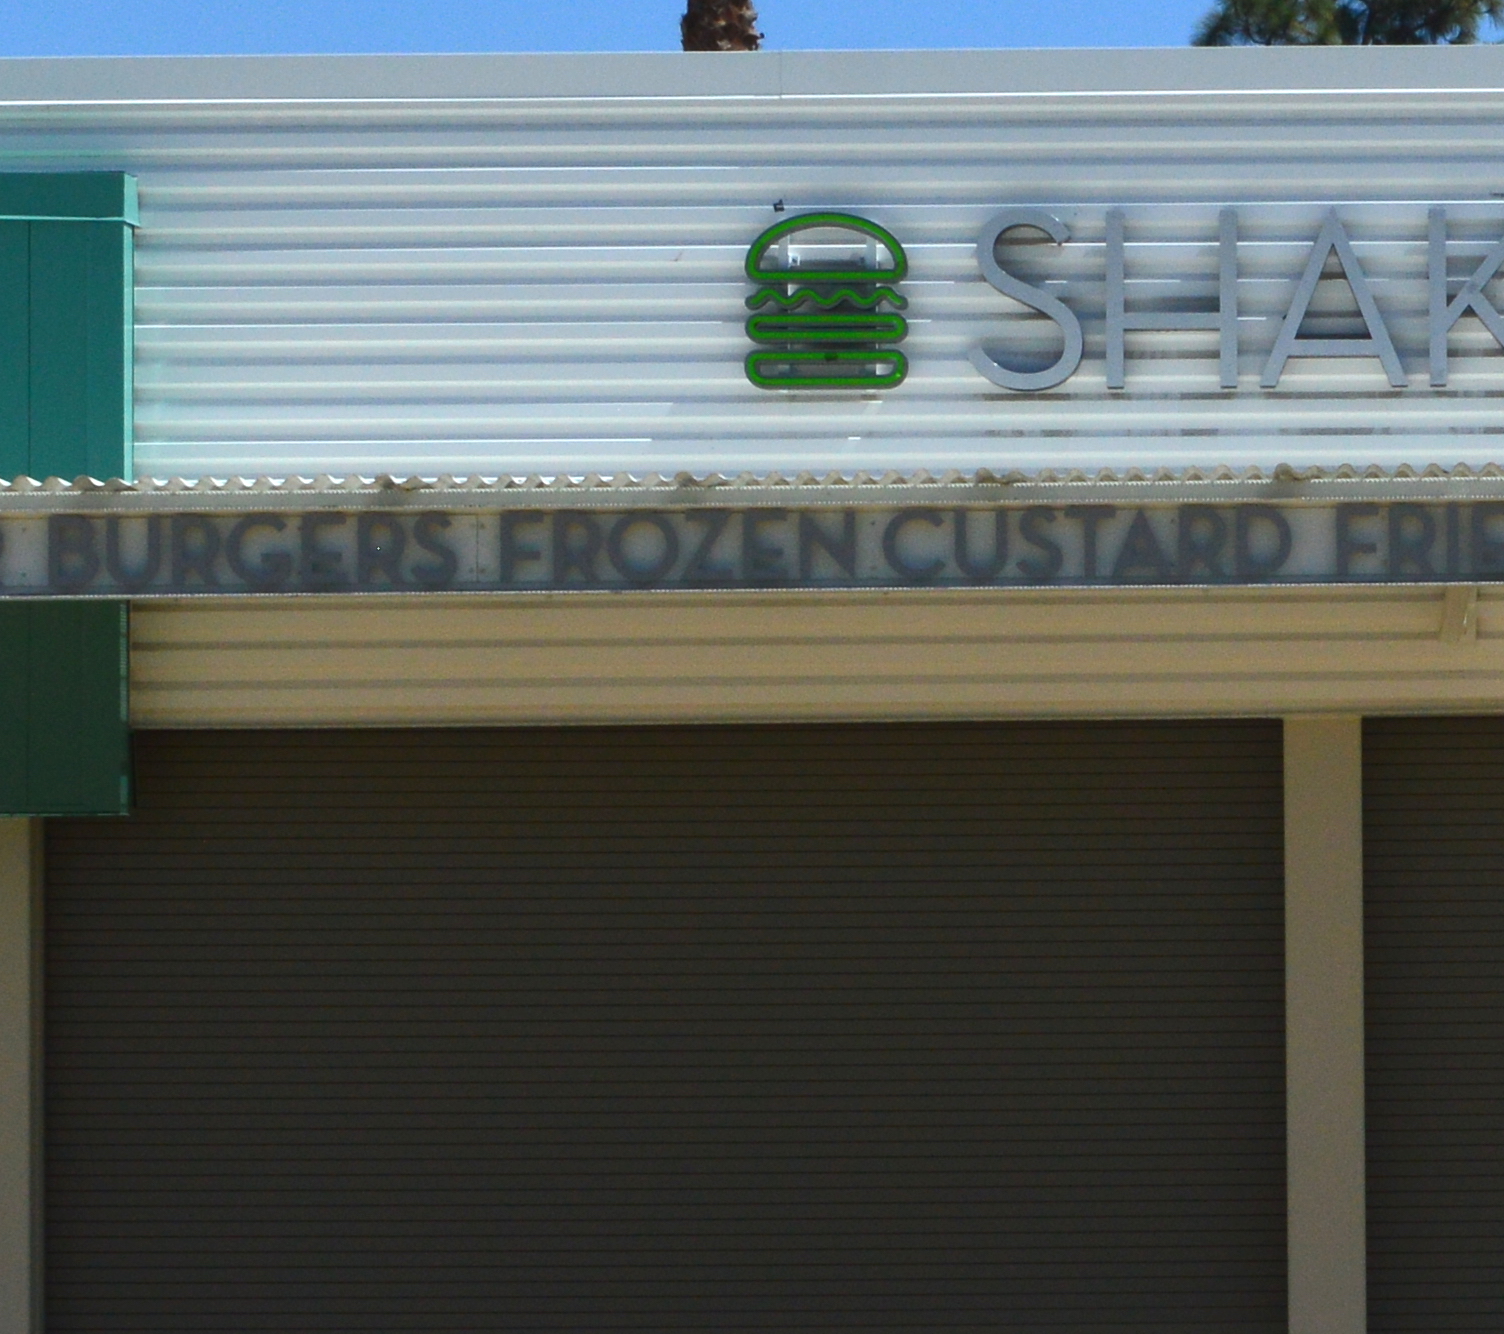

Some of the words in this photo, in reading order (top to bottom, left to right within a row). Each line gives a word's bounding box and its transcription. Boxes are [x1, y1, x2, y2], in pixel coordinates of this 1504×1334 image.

[48, 509, 458, 589] BURGERS
[498, 507, 856, 585] FROZEN
[881, 503, 1294, 584] CUSTARD
